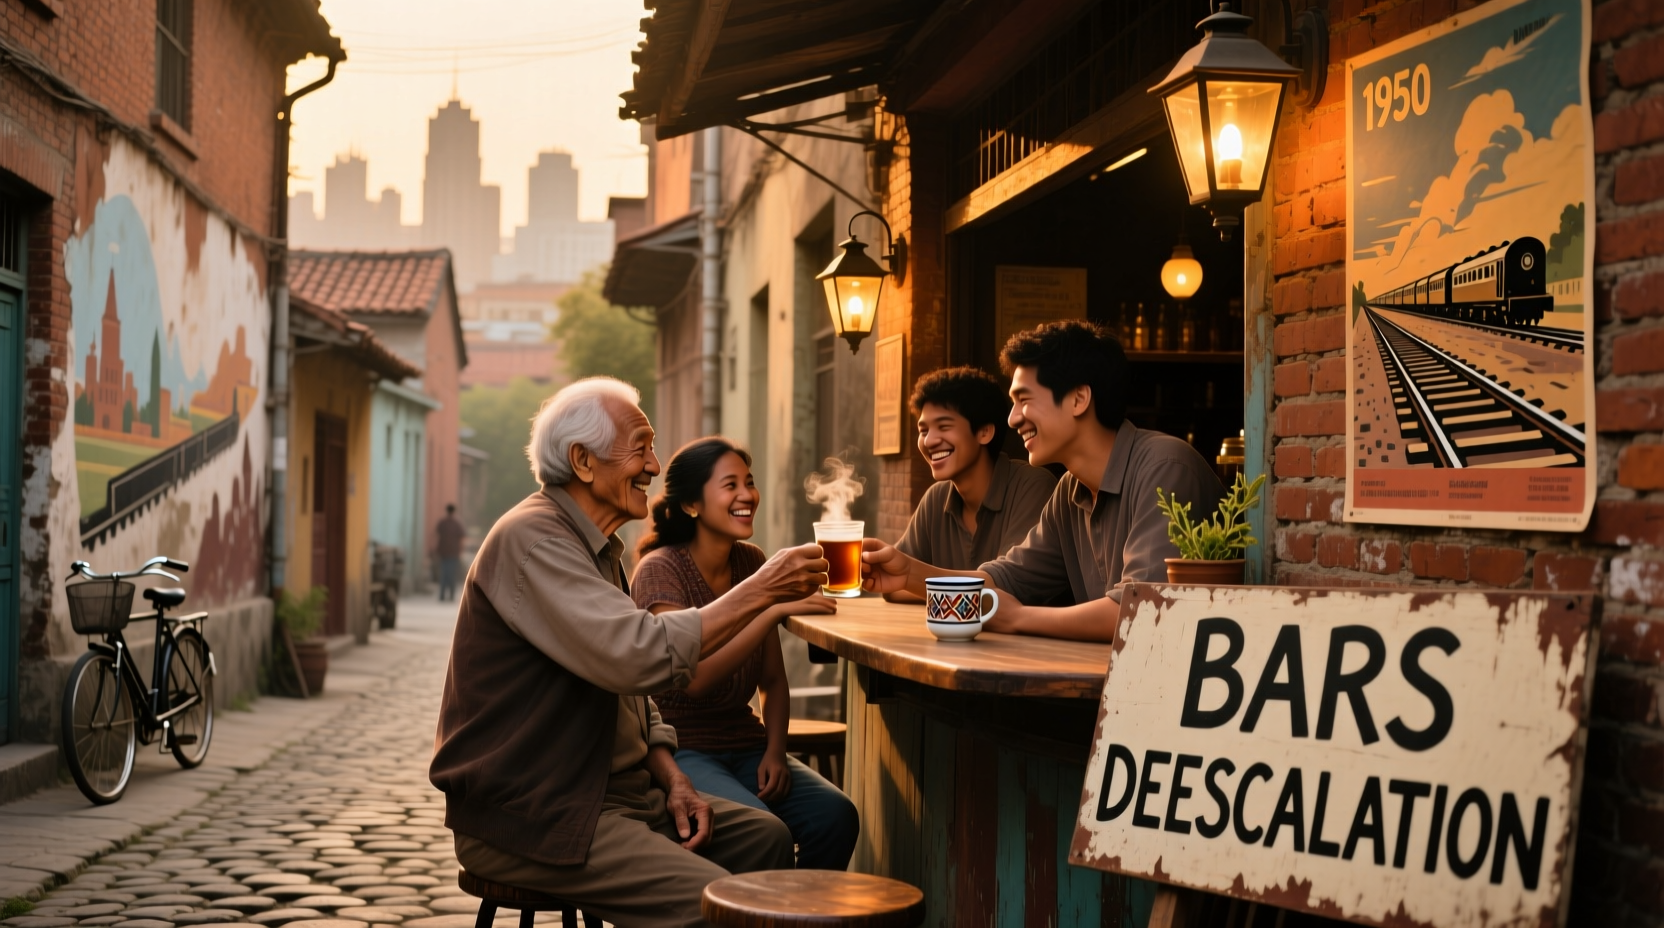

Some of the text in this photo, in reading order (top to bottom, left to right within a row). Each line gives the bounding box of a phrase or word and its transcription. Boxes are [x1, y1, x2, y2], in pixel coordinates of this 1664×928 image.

[1362, 63, 1431, 131] 1950
[1180, 617, 1461, 752] BARS
[1096, 743, 1550, 891] DEESCALATION
